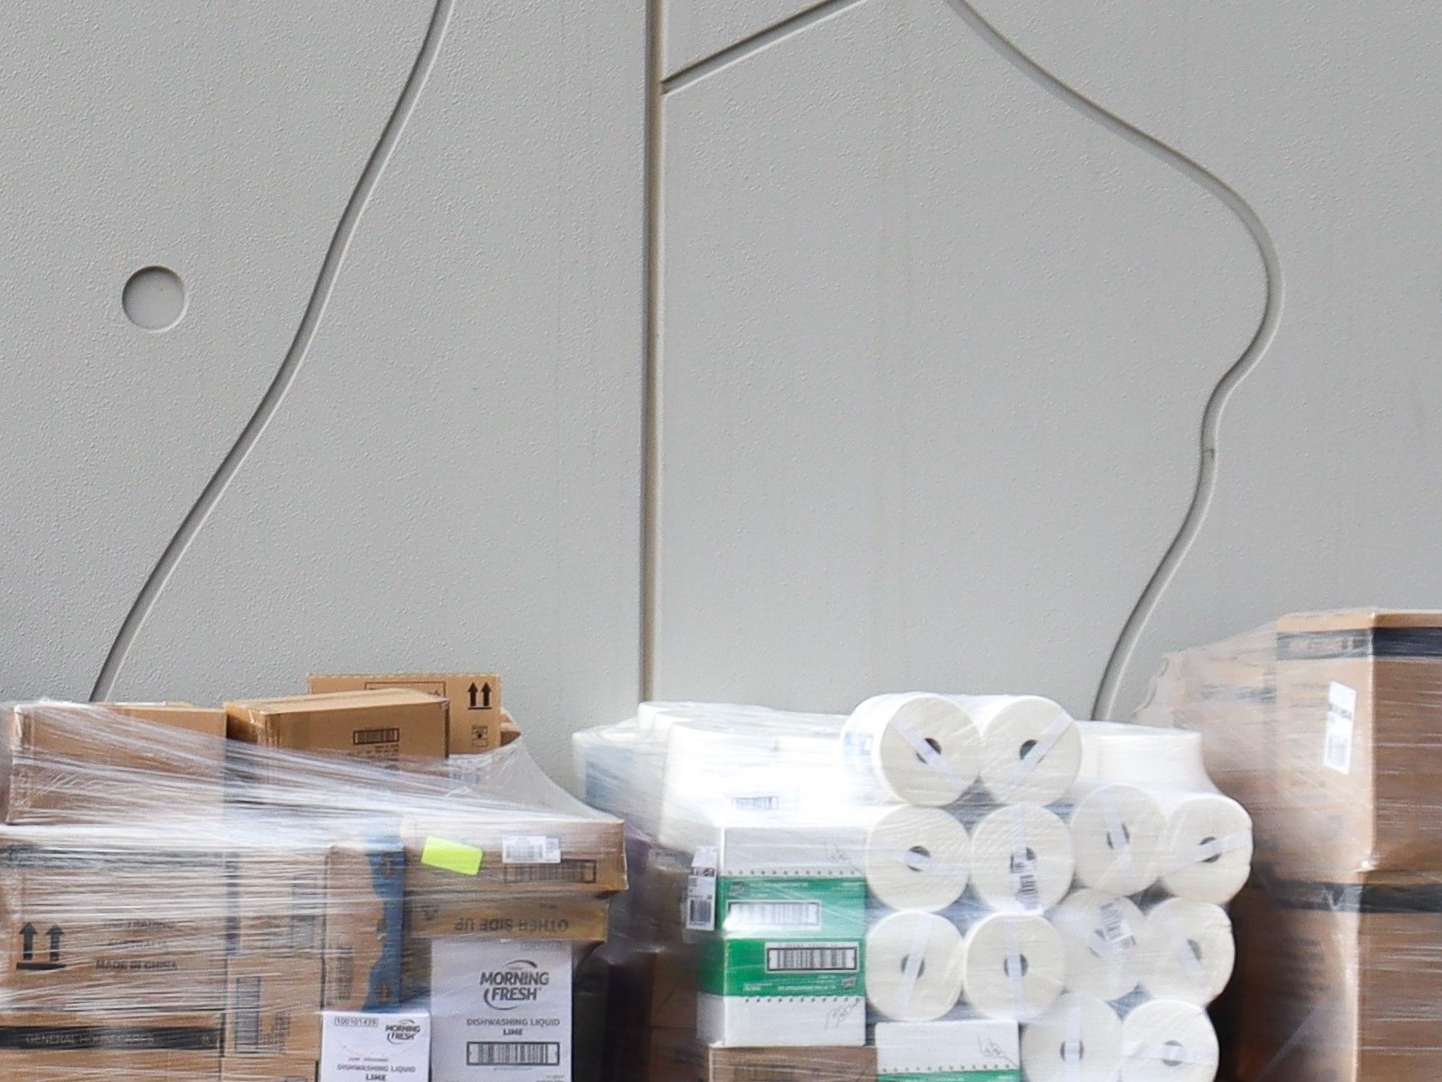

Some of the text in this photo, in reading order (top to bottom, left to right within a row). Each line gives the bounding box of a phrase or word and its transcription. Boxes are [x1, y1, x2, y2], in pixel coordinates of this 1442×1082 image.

[454, 919, 569, 933] OTHER SIDE UP
[480, 971, 549, 986] MORNING
[490, 988, 537, 1001] FRESH
[386, 1024, 420, 1032] MORNING
[466, 1018, 560, 1027] DISHWASHING LIQUID
[503, 1028, 524, 1036] LIME
